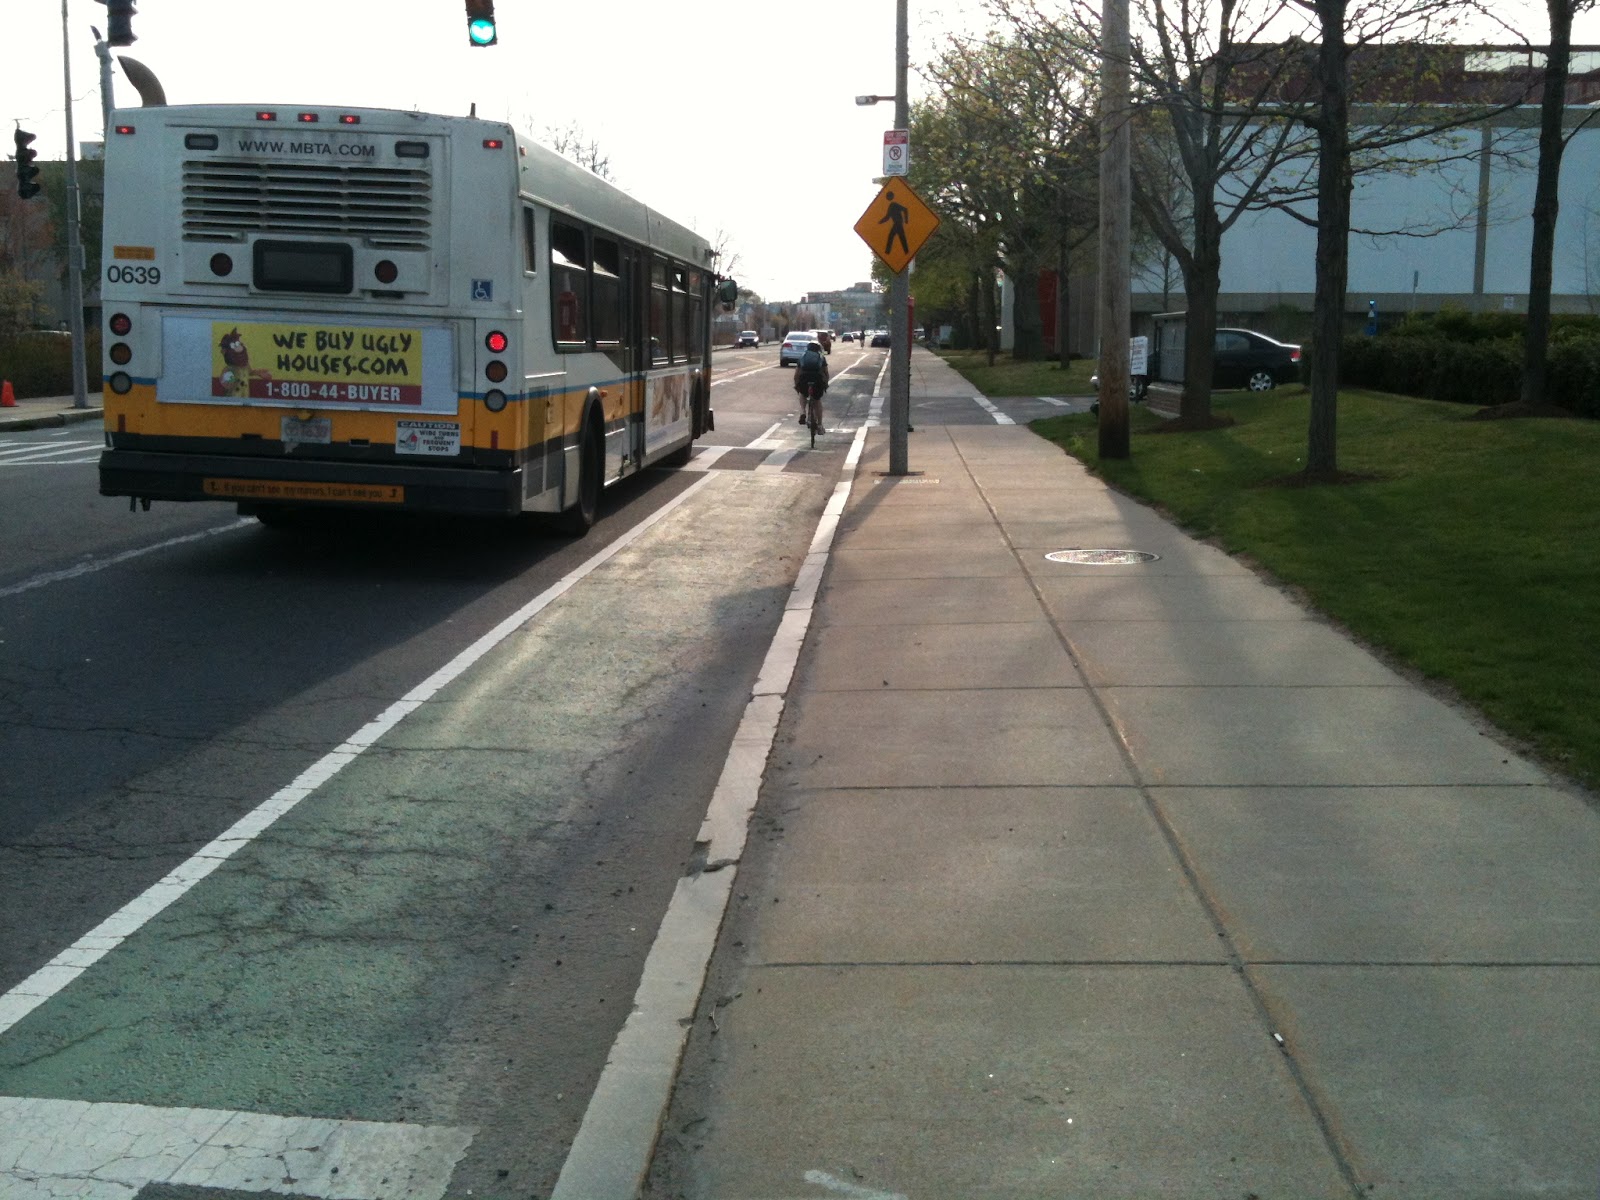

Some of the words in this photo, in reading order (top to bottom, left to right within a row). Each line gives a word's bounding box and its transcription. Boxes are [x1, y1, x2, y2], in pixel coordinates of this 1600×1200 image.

[238, 140, 376, 156] WWW.MBTA.COM
[107, 265, 161, 285] 0639
[273, 331, 307, 349] WE
[315, 331, 354, 351] BUY
[362, 332, 412, 355] UGLY
[277, 353, 409, 376] HOUSES.COM
[266, 382, 401, 401] 1-800-44-BUYER
[400, 421, 456, 429] CAUTION
[231, 484, 245, 494] you
[246, 484, 265, 493] can't
[267, 485, 281, 494] see
[332, 487, 352, 497] can't
[353, 488, 367, 497] see
